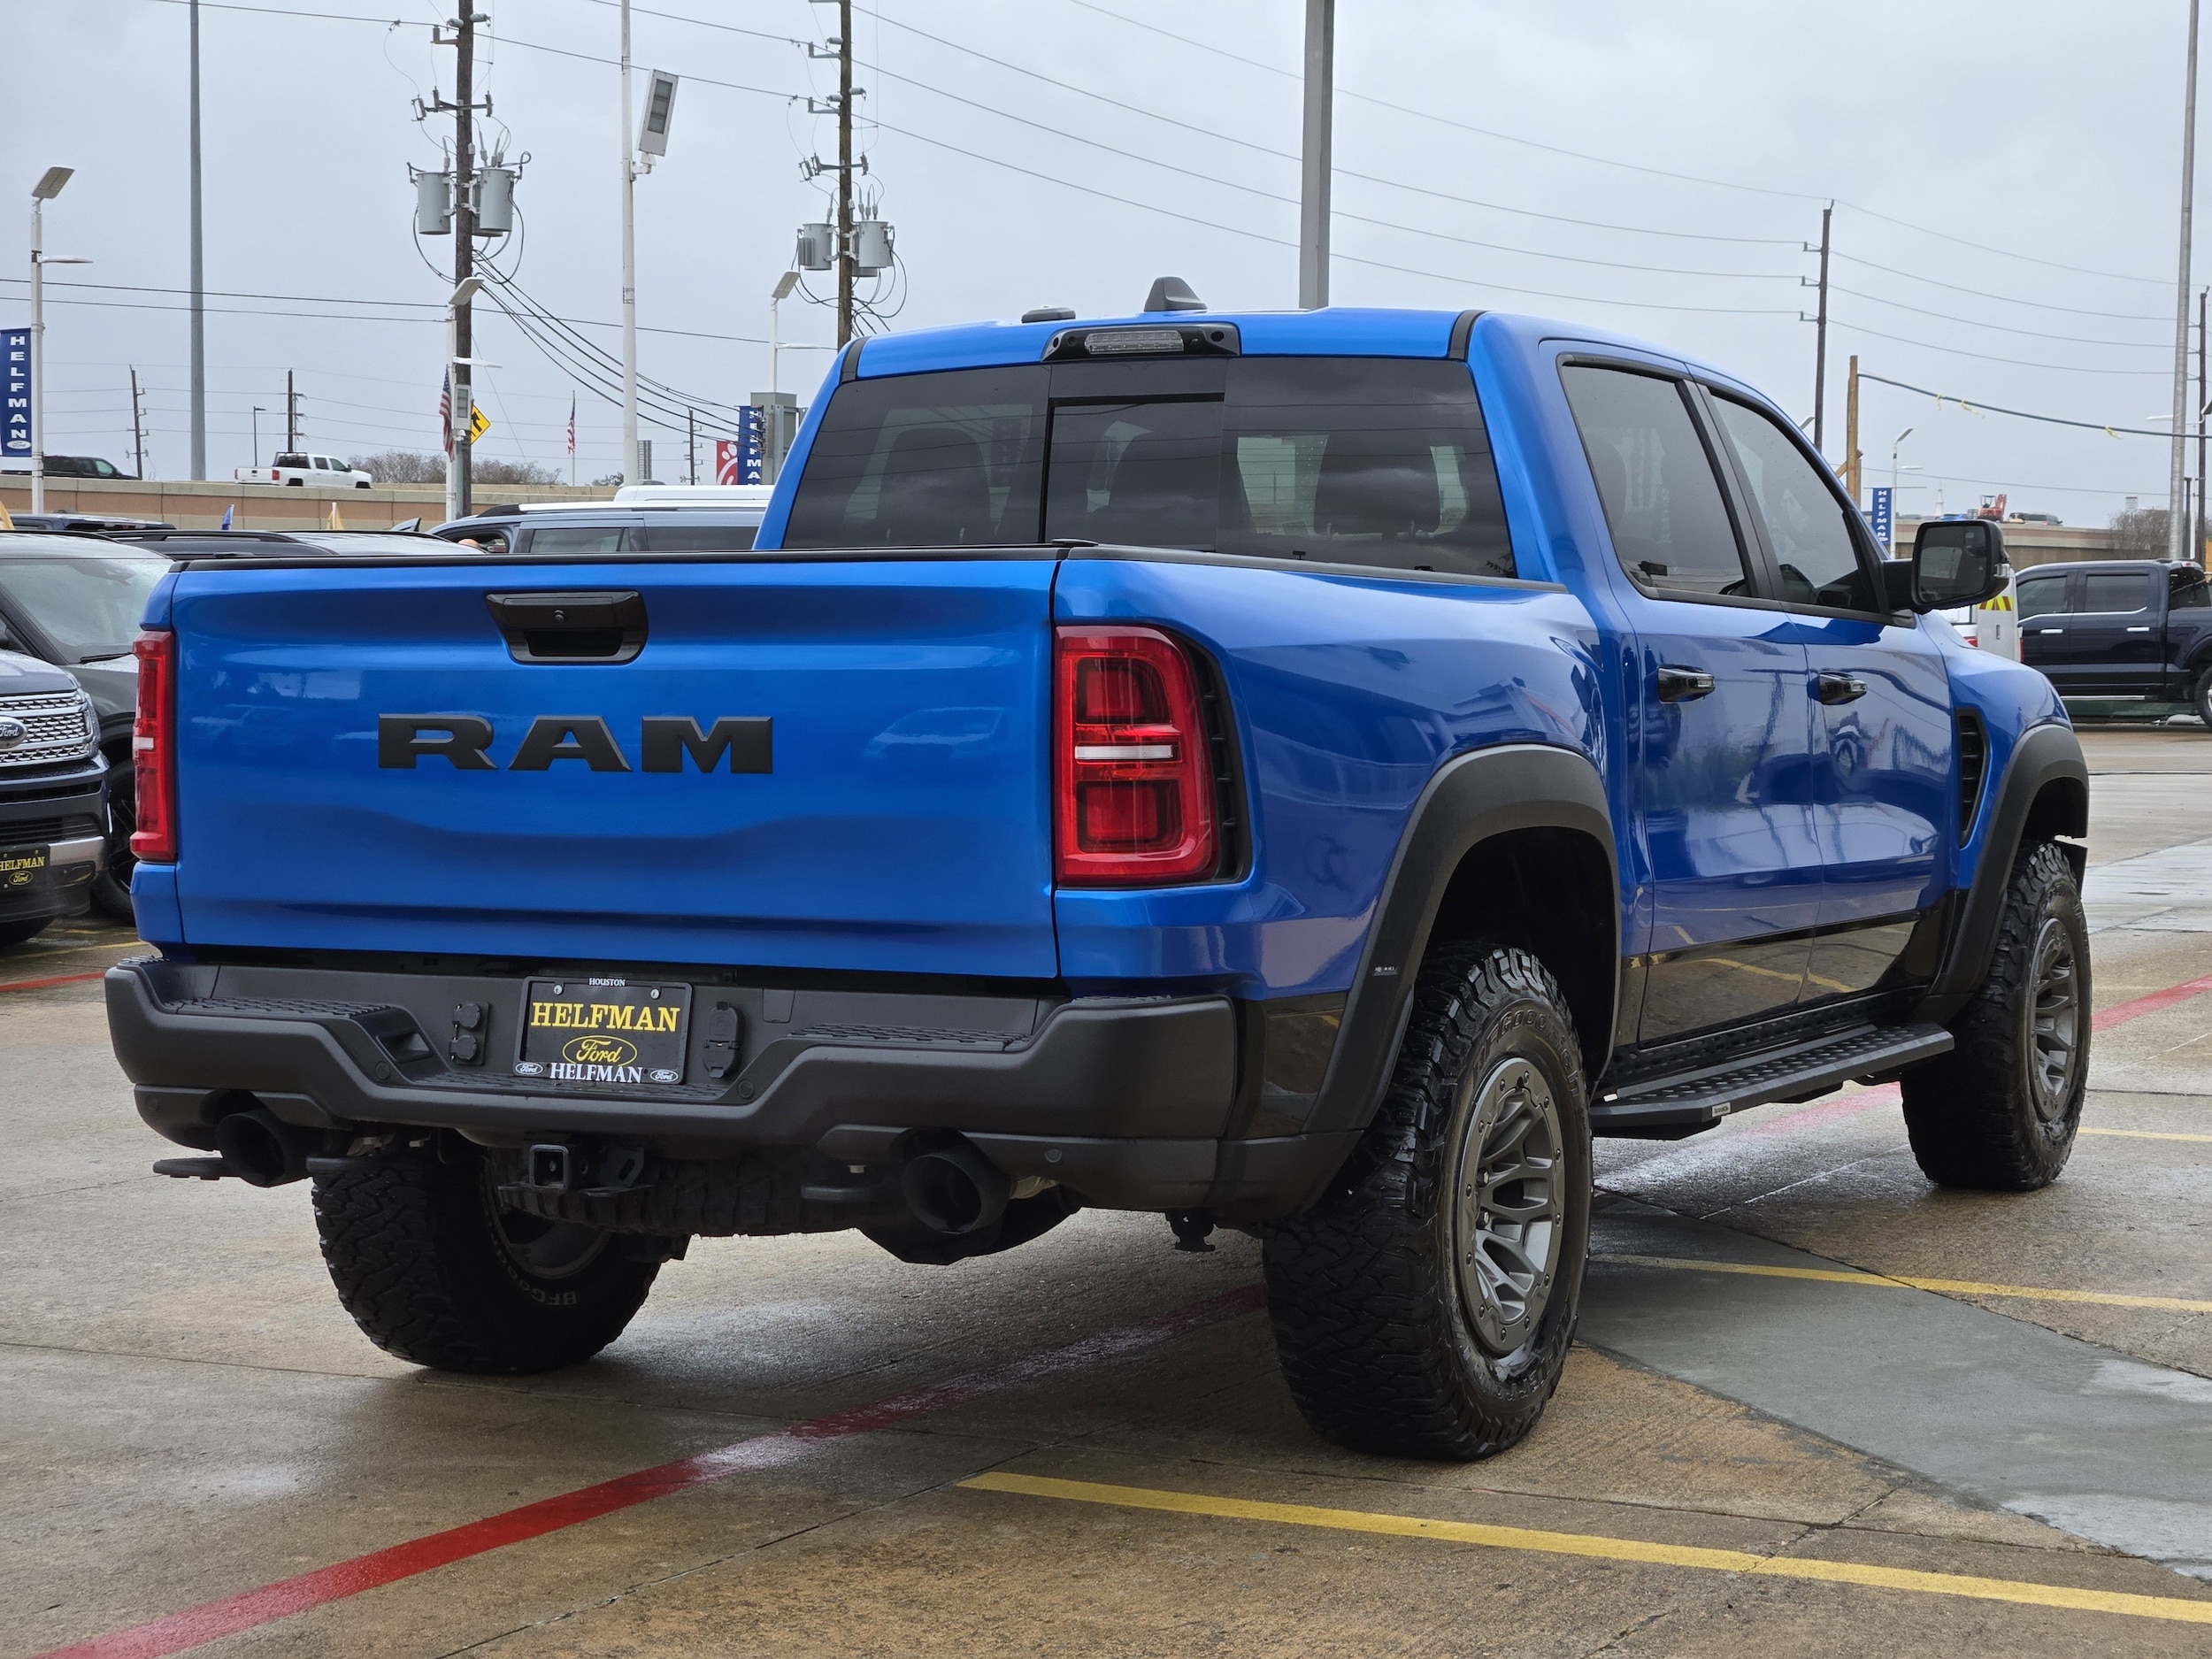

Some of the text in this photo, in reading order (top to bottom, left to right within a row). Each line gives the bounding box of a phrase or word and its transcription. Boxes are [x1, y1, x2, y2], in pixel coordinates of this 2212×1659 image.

[8, 335, 27, 439] HELFMAN
[1877, 490, 1887, 537] HELFMAN
[378, 712, 773, 774] RAM
[588, 977, 626, 987] HOUSTON
[530, 1002, 680, 1033] HELFMAN
[575, 1037, 623, 1064] Ford
[519, 1061, 674, 1084] Ford HELFMAN Ford
